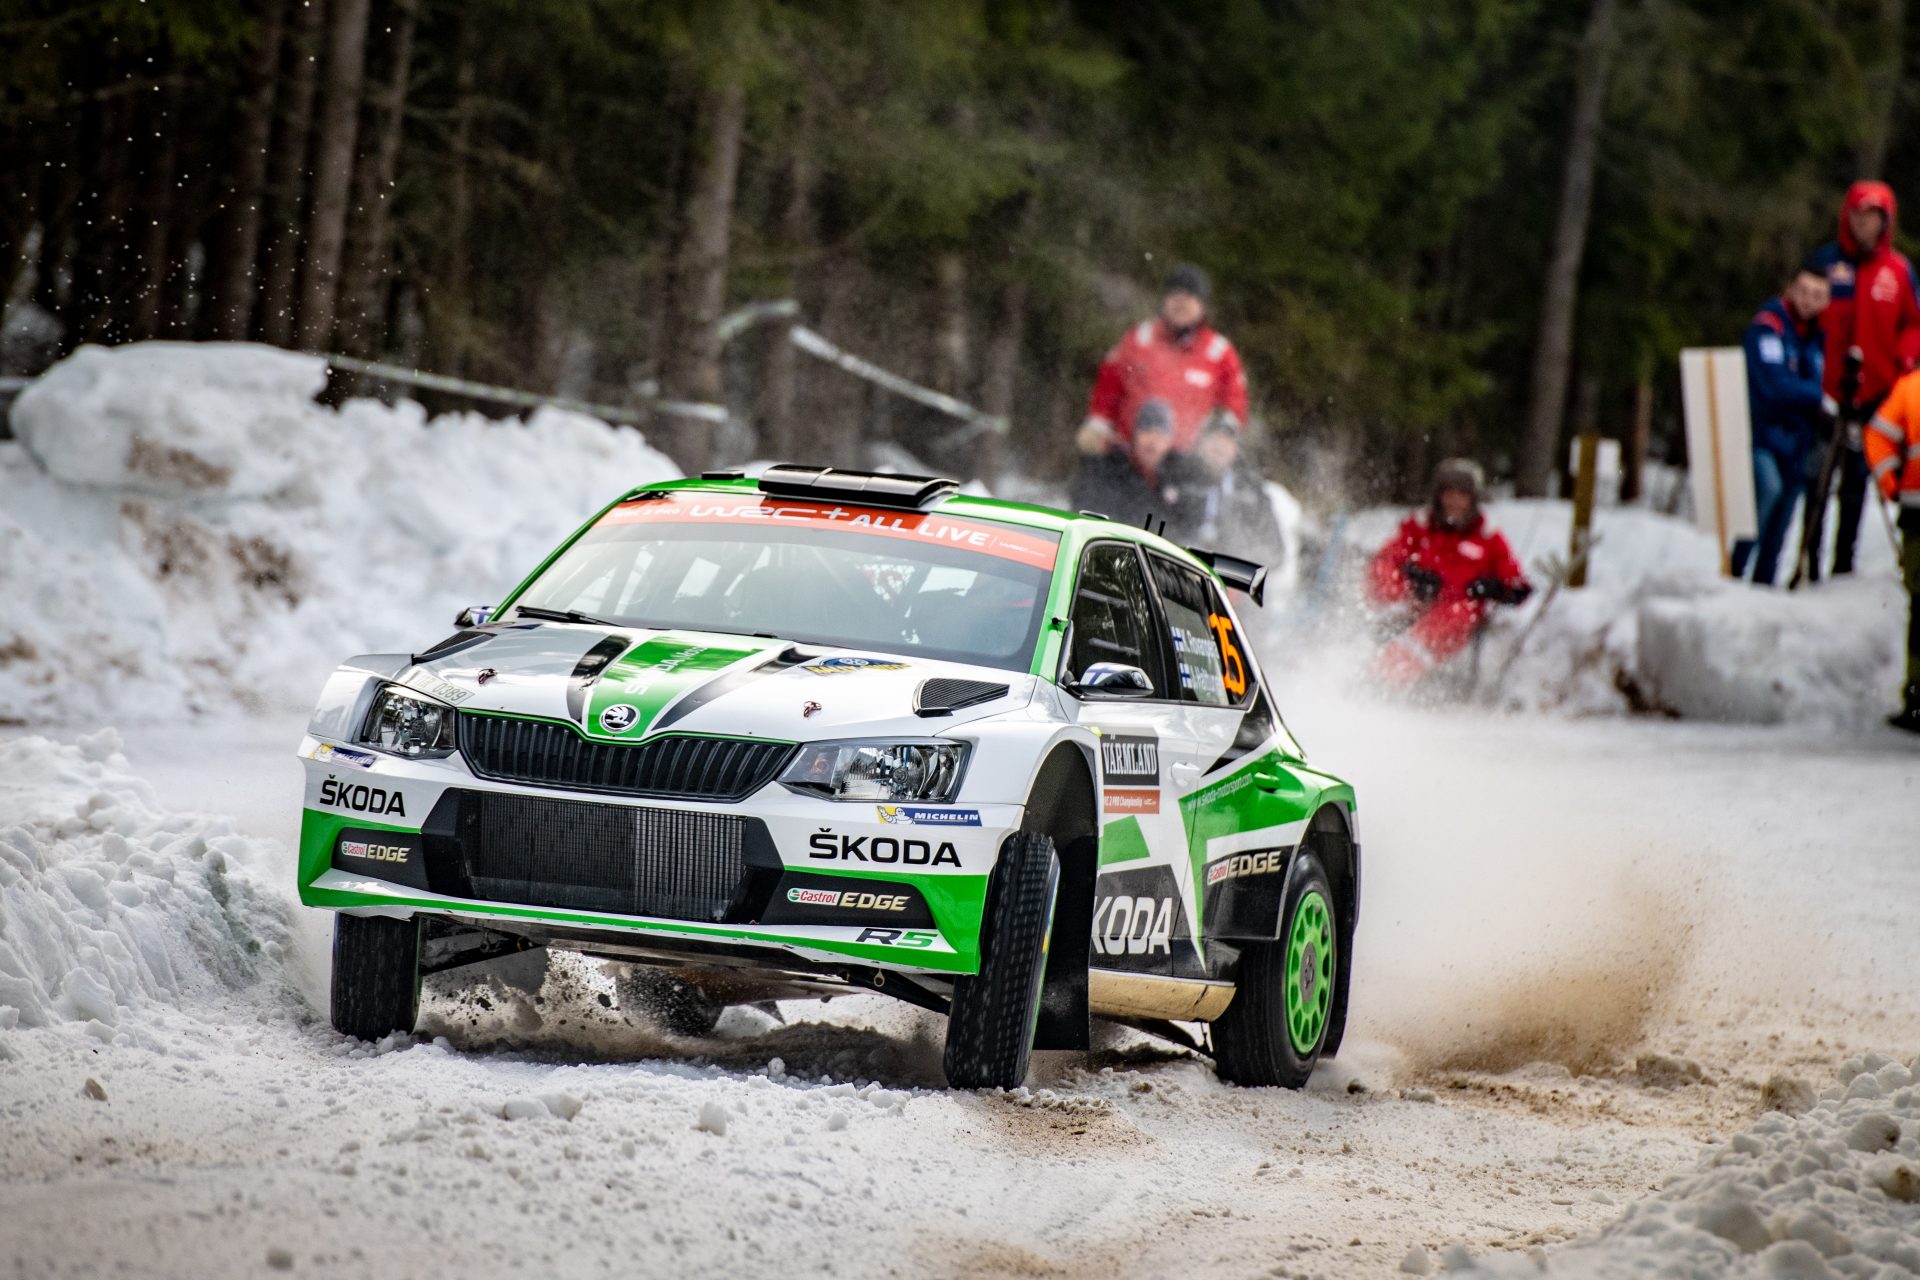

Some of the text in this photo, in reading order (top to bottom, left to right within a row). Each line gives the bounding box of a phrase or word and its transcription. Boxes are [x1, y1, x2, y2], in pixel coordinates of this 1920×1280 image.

[848, 514, 907, 532] ALL
[917, 523, 989, 546] LIVE
[432, 682, 467, 701] 0389
[1102, 733, 1157, 775] VÄRMLAND
[319, 774, 406, 817] ŠKODA
[914, 811, 979, 821] MICHELIN
[366, 844, 412, 863] EDGE
[809, 827, 962, 867] ŠKODA
[1228, 851, 1282, 878] EDGE
[800, 890, 911, 911] Castrol EDGE
[855, 928, 938, 947] R5
[1091, 896, 1172, 954] KODA
